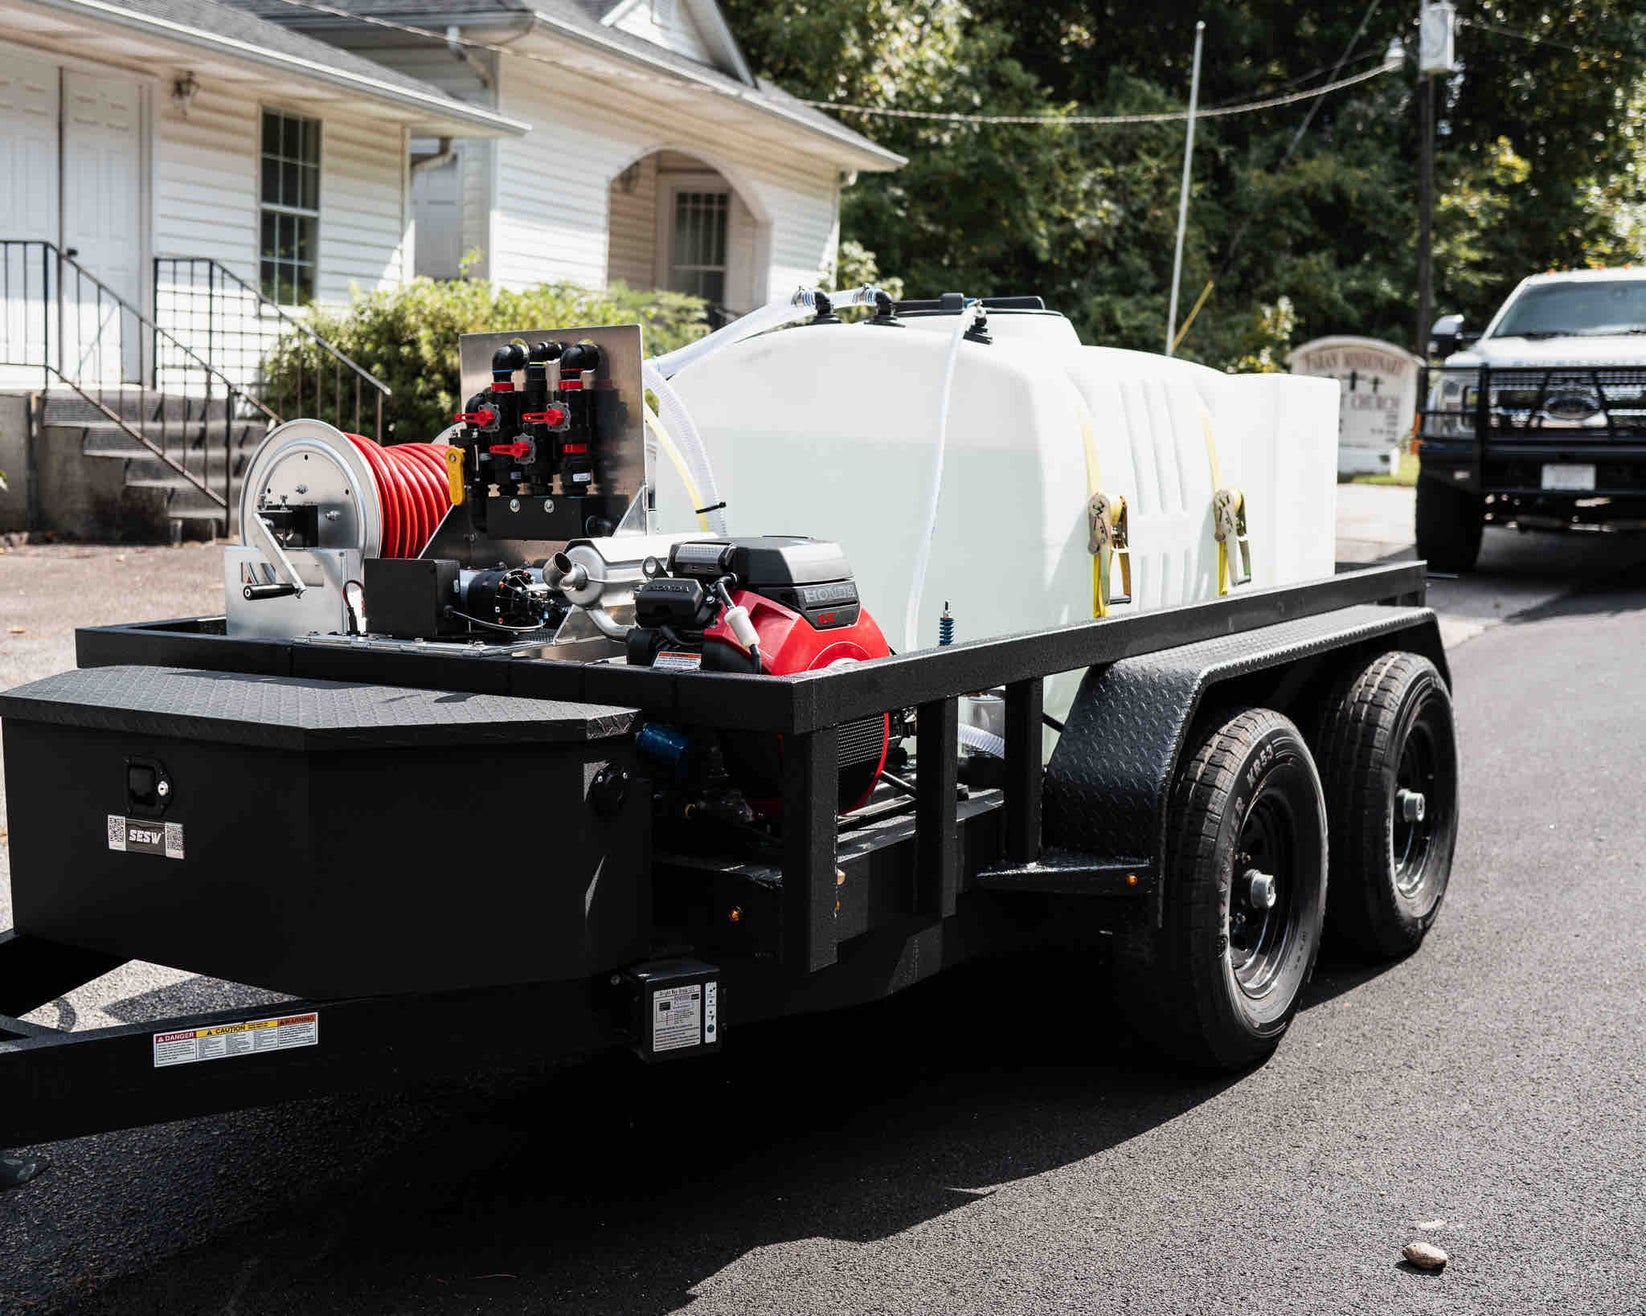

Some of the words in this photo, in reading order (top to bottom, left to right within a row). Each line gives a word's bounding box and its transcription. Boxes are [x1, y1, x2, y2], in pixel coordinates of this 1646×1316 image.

[128, 829, 162, 845] SESW
[284, 1015, 315, 1025] WARNING
[215, 1024, 246, 1035] CAUTION
[164, 1032, 195, 1042] DANGER
